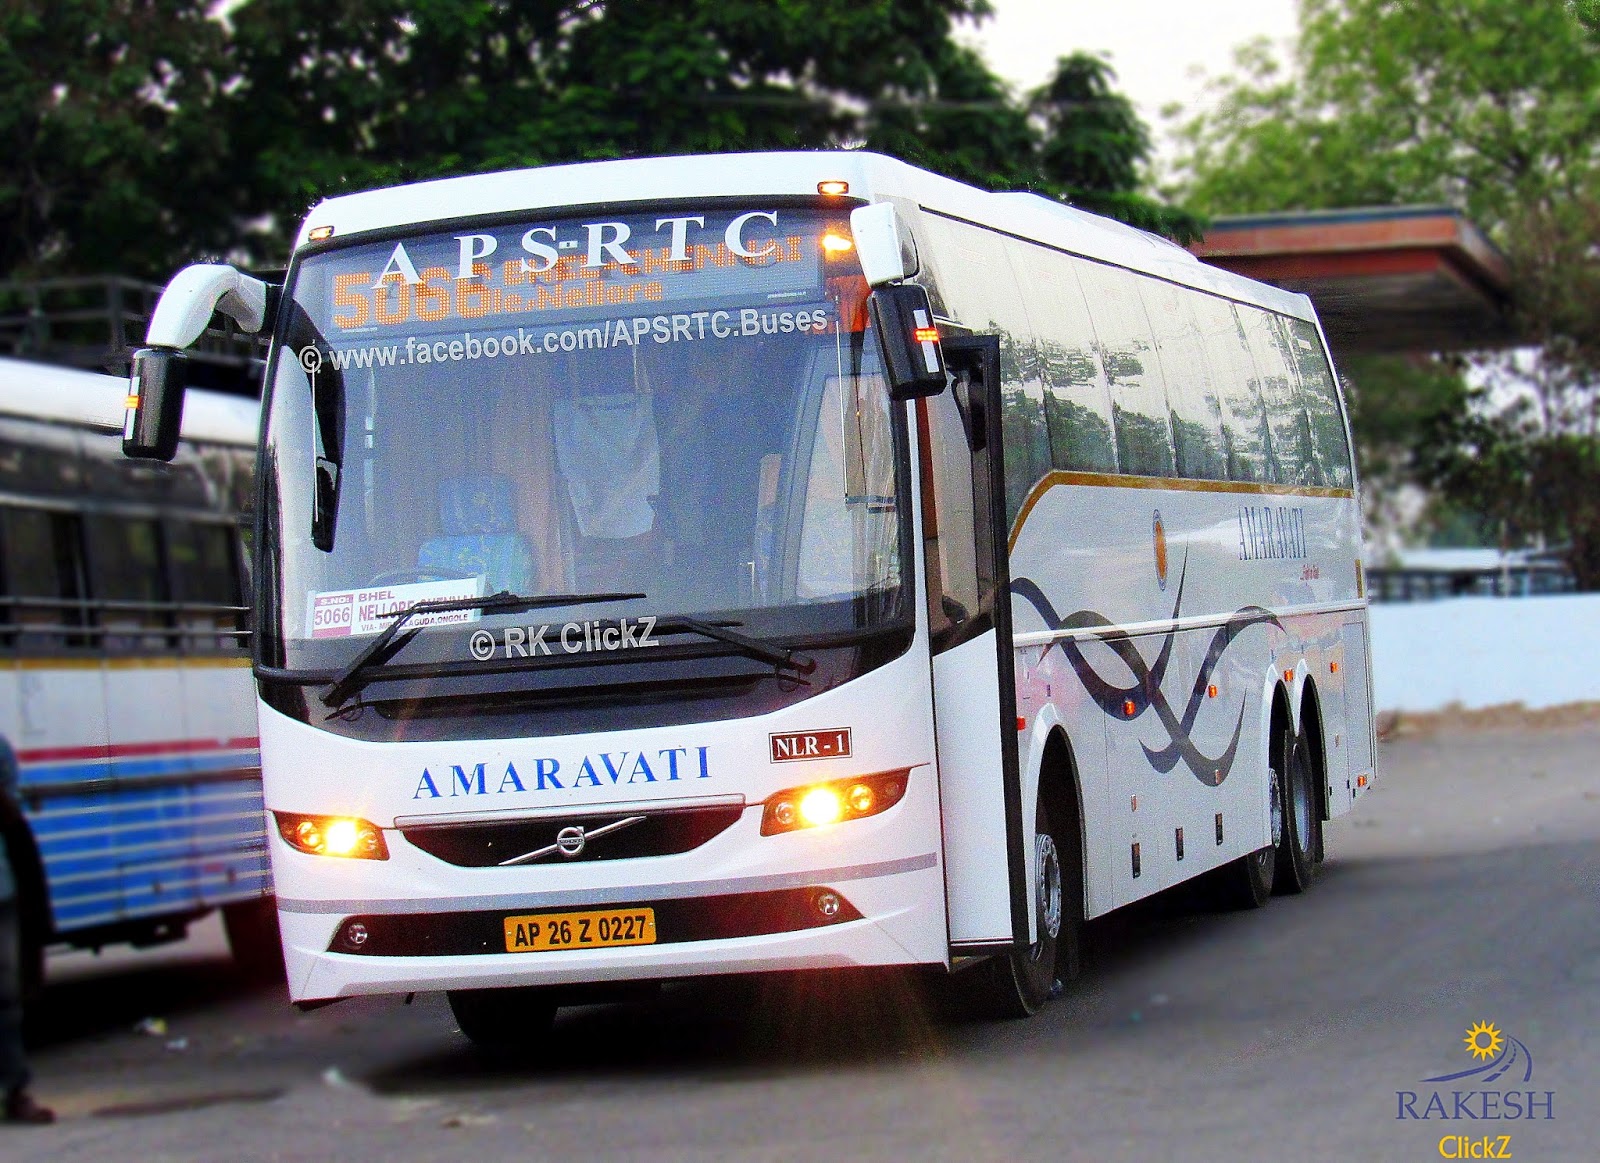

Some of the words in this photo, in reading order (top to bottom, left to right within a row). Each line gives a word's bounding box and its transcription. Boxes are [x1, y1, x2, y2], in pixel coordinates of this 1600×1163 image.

[333, 263, 492, 329] 5066
[1238, 506, 1308, 561] AMARAVATI
[358, 591, 395, 602] BHEL
[315, 607, 350, 626] 5066
[775, 736, 819, 758] NLR
[836, 734, 844, 753] 1
[413, 746, 713, 800] AMARAVATI
[515, 922, 541, 947] AP
[548, 919, 572, 944] 26
[578, 918, 592, 943] Z
[599, 914, 647, 942] 0227
